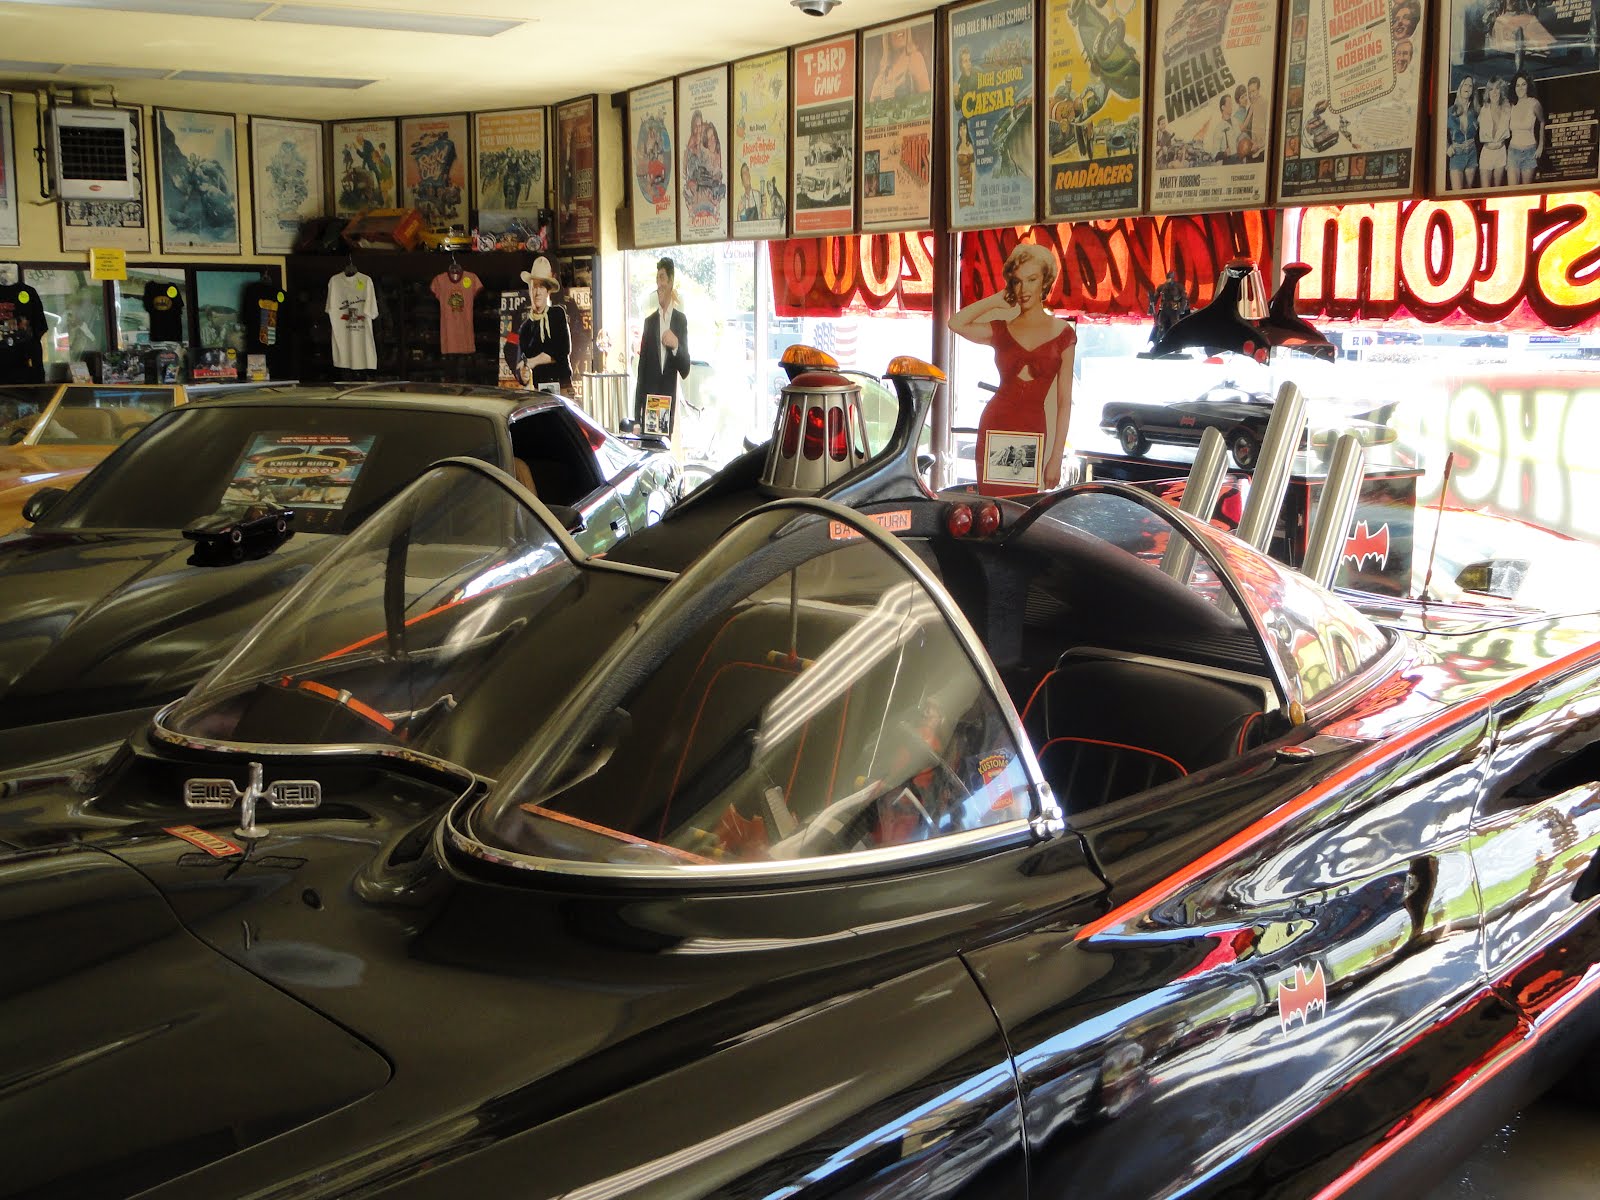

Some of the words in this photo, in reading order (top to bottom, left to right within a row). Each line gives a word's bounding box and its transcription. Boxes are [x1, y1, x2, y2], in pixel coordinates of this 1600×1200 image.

[953, 23, 966, 38] MOB
[966, 19, 980, 35] RULE
[980, 17, 987, 32] IN
[987, 15, 992, 30] A
[992, 12, 1006, 28] HIGH
[1006, 3, 1031, 25] SCHOOL!
[1328, 1, 1386, 39] NASHVILLE
[1557, 11, 1573, 19] HAVE
[1344, 31, 1373, 52] MARTY
[1336, 39, 1383, 71] ROBBINS
[814, 74, 842, 97] GANG
[977, 71, 995, 89] HIGH
[996, 66, 1024, 85] SCHOOL
[1164, 51, 1213, 97] HELL
[1164, 66, 1236, 125] WHEELS
[1339, 78, 1383, 98] TECHNICOLOR
[1340, 85, 1384, 105] TECHNISCOPE
[961, 86, 1015, 119] CAESAR
[1159, 175, 1178, 189] MARTY
[1178, 174, 1200, 188] ROBBINS
[875, 513, 909, 529] TURN
[977, 758, 1010, 775] KUSTOMS
